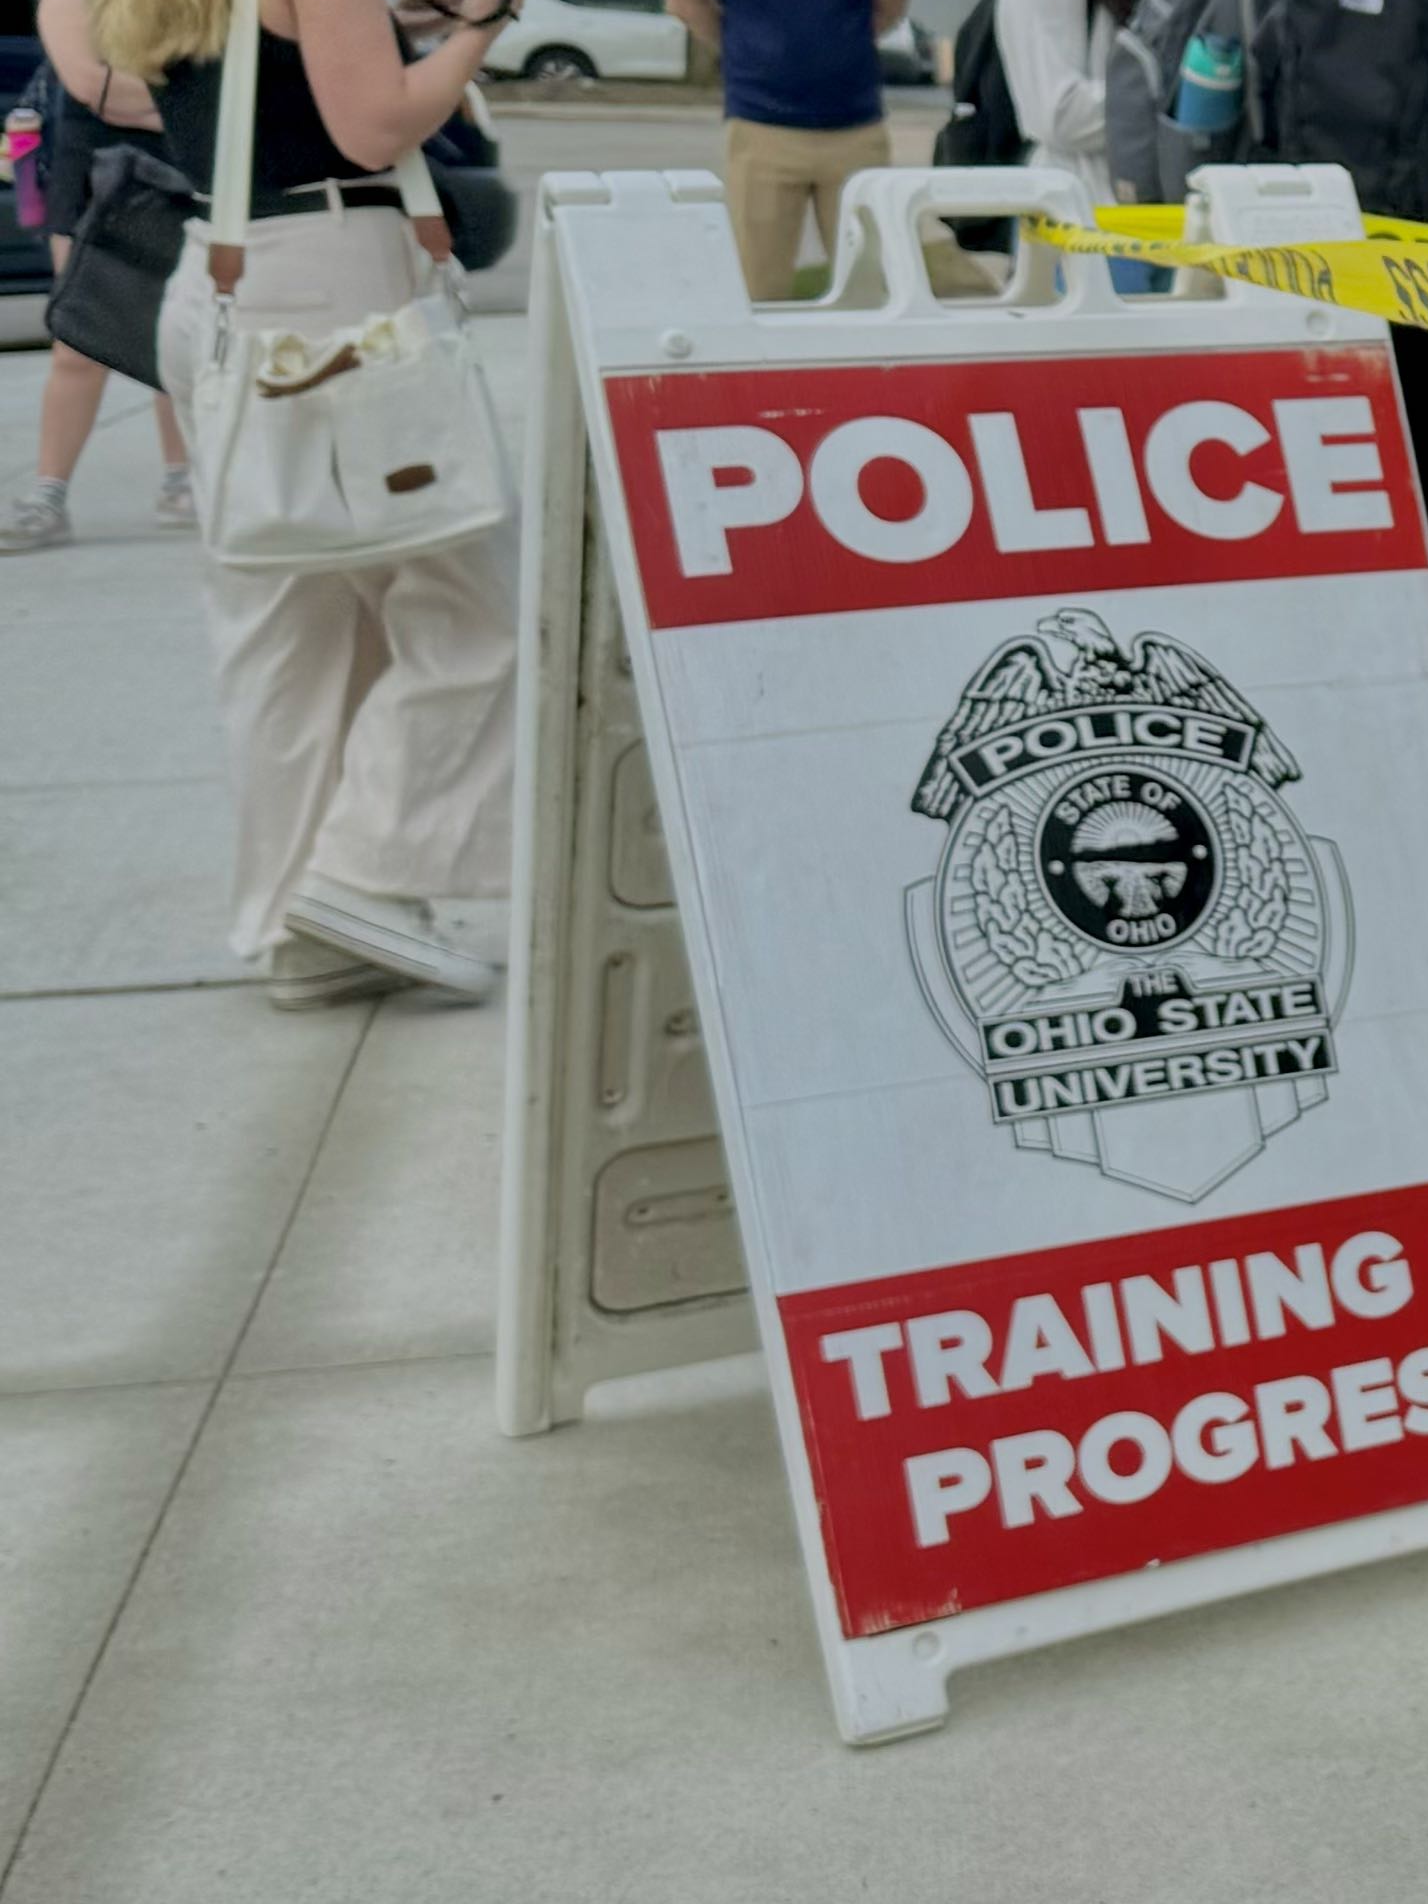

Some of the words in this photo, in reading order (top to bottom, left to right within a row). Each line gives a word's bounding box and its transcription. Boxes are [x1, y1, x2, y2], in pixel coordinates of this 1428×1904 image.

[655, 395, 1395, 579] POLICE
[980, 710, 1228, 776] POLICE
[1055, 774, 1132, 825] STATE
[1140, 781, 1182, 812] OF
[1106, 913, 1177, 944] OHIO
[1128, 971, 1177, 995] THE
[988, 1007, 1137, 1057] OHIO
[1157, 982, 1317, 1034] STATE
[1001, 1037, 1324, 1116] UNIVERSITY
[820, 1229, 1414, 1421] TRAINING
